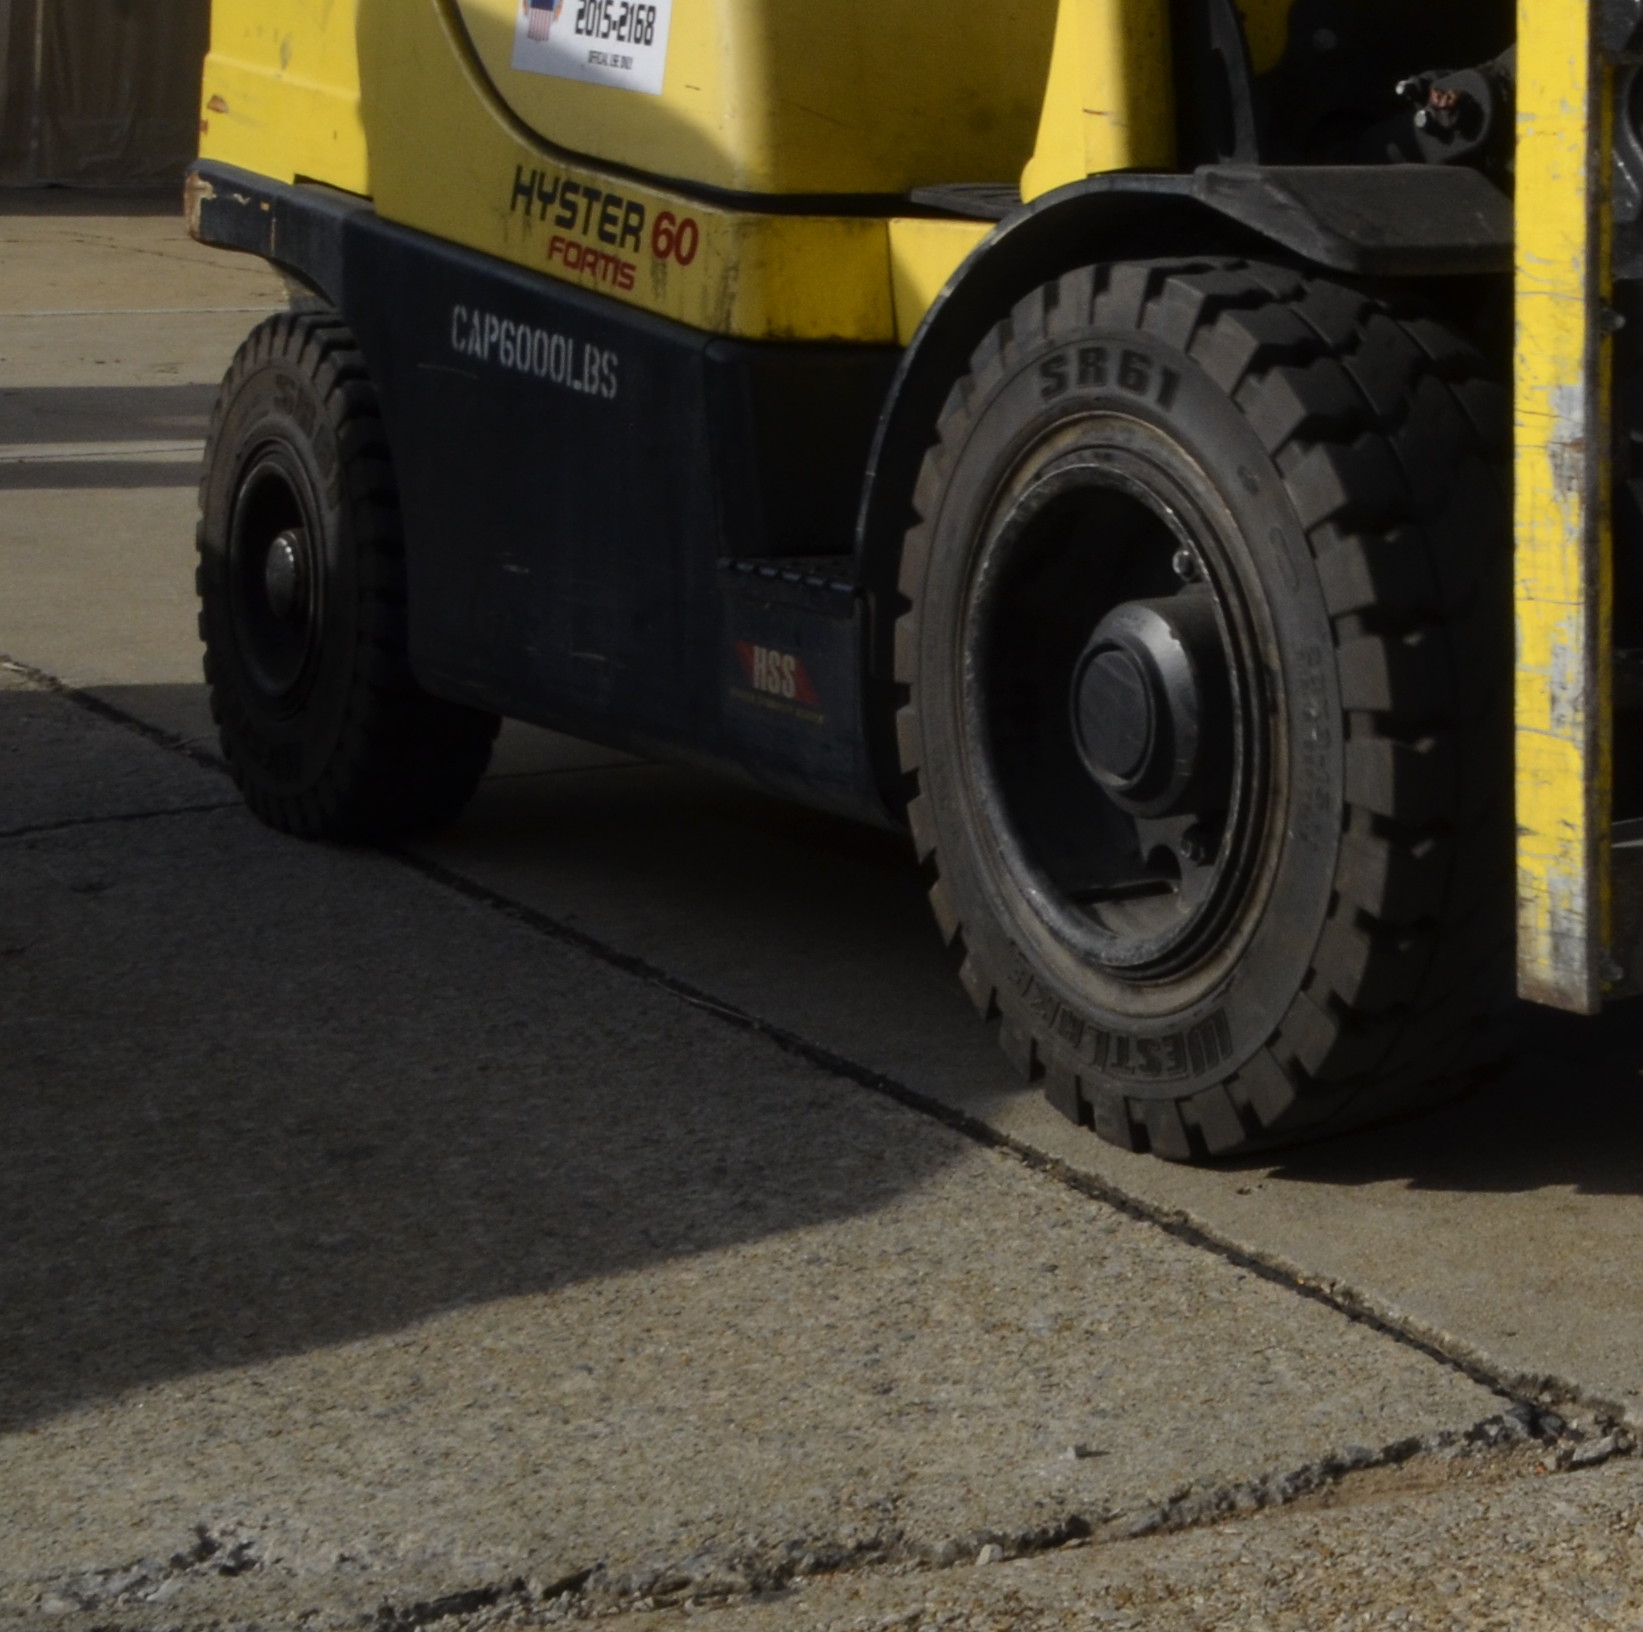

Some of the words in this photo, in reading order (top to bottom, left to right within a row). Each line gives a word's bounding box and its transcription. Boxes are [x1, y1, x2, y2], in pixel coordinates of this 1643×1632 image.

[510, 164, 646, 253] HYSTER
[652, 210, 700, 267] 60
[548, 234, 637, 292] FORTIS
[450, 303, 620, 401] CAP6000LBS
[1040, 346, 1182, 412] SR61
[752, 644, 797, 700] HSS
